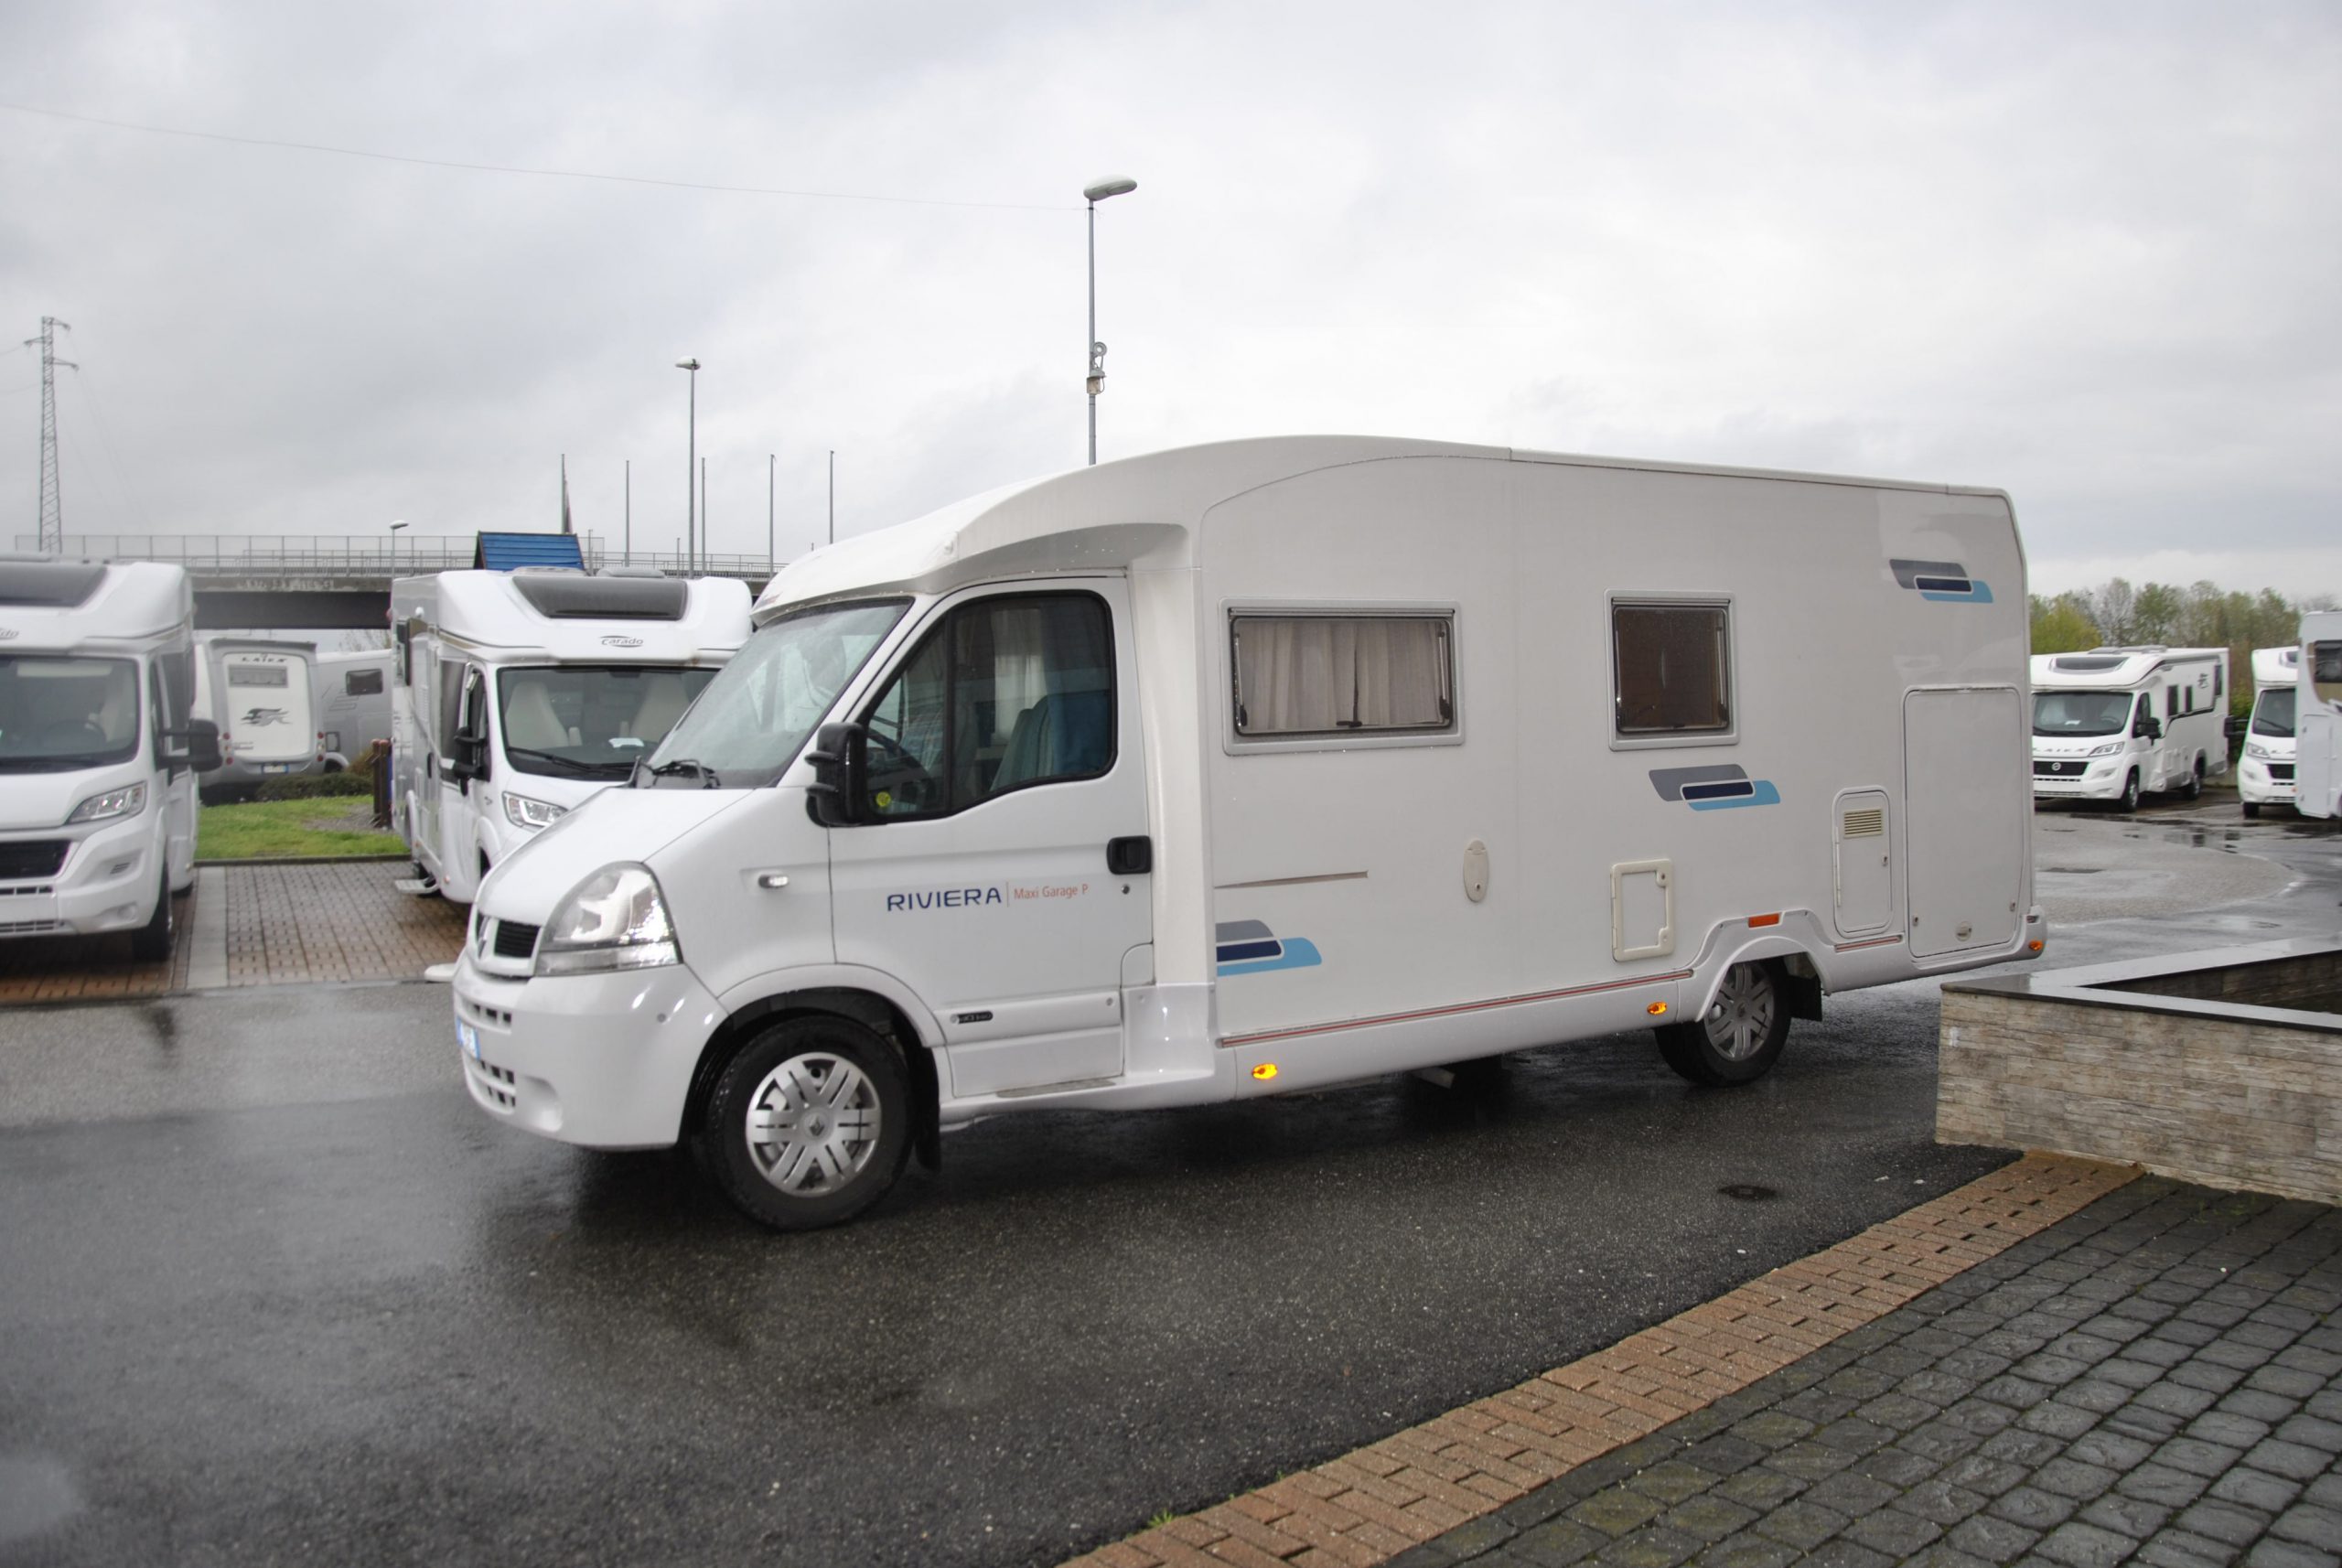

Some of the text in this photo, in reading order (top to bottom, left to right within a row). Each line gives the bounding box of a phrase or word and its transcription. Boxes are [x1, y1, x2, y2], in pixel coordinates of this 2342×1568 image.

[886, 884, 1089, 912] RIVIERA Maxi Garage P
